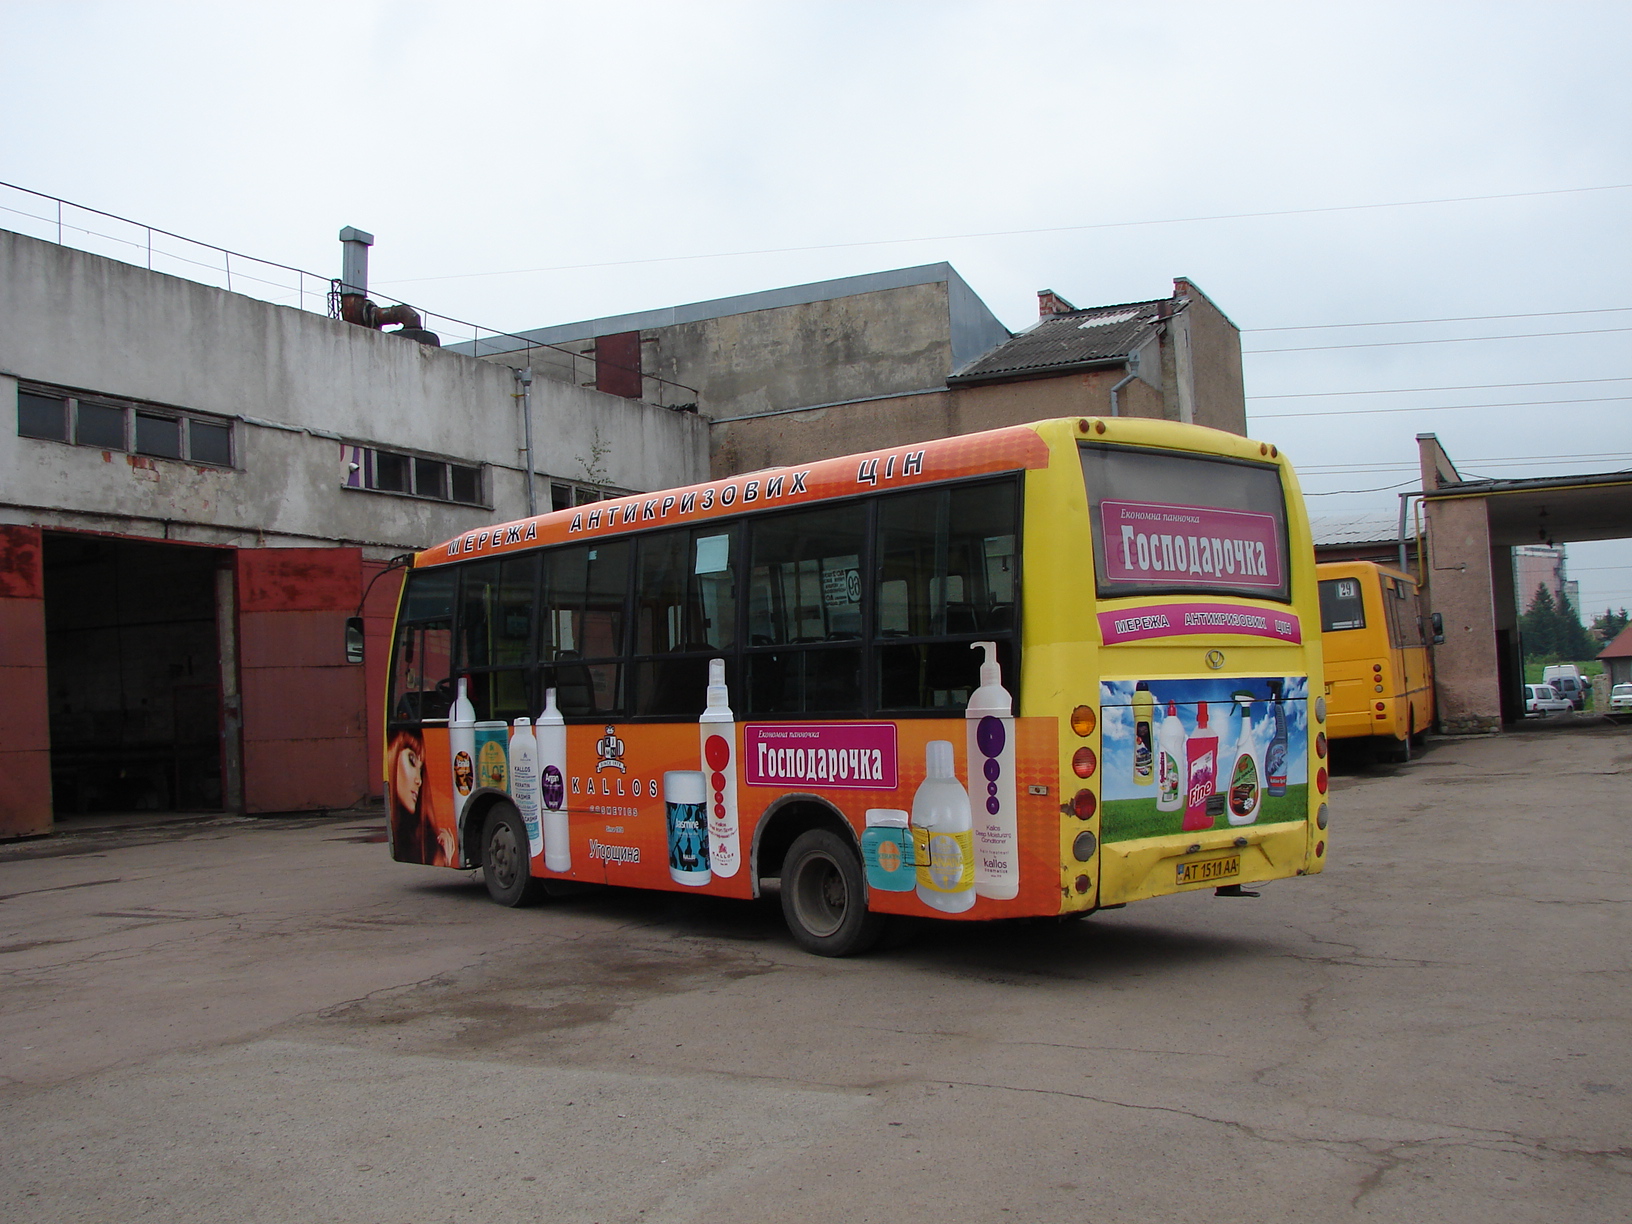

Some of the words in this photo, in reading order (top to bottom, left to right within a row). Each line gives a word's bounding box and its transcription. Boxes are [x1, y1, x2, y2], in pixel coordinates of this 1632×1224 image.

[447, 521, 538, 556] МЕРЕЖА
[568, 469, 811, 533] АНТИКРИЗОВИХ
[856, 449, 926, 487] ЦІН
[1120, 508, 1161, 521] Економна
[1162, 513, 1200, 524] панночка
[1120, 524, 1268, 578] Господарочка
[1340, 582, 1352, 596] 29
[1115, 614, 1170, 634] МЕРЕЖА
[1184, 612, 1268, 630] АНТИКРИЗОВИХ
[1274, 619, 1292, 635] ЦІН
[757, 742, 883, 782] Господарочка
[571, 776, 658, 798] KALLOS
[1189, 780, 1213, 808] Fine
[589, 839, 640, 866] Угорщина
[926, 854, 964, 868] ANANA
[983, 857, 1008, 869] kallos
[1183, 864, 1199, 881] AT
[1200, 861, 1222, 878] 1511
[1223, 858, 1237, 875] AA
